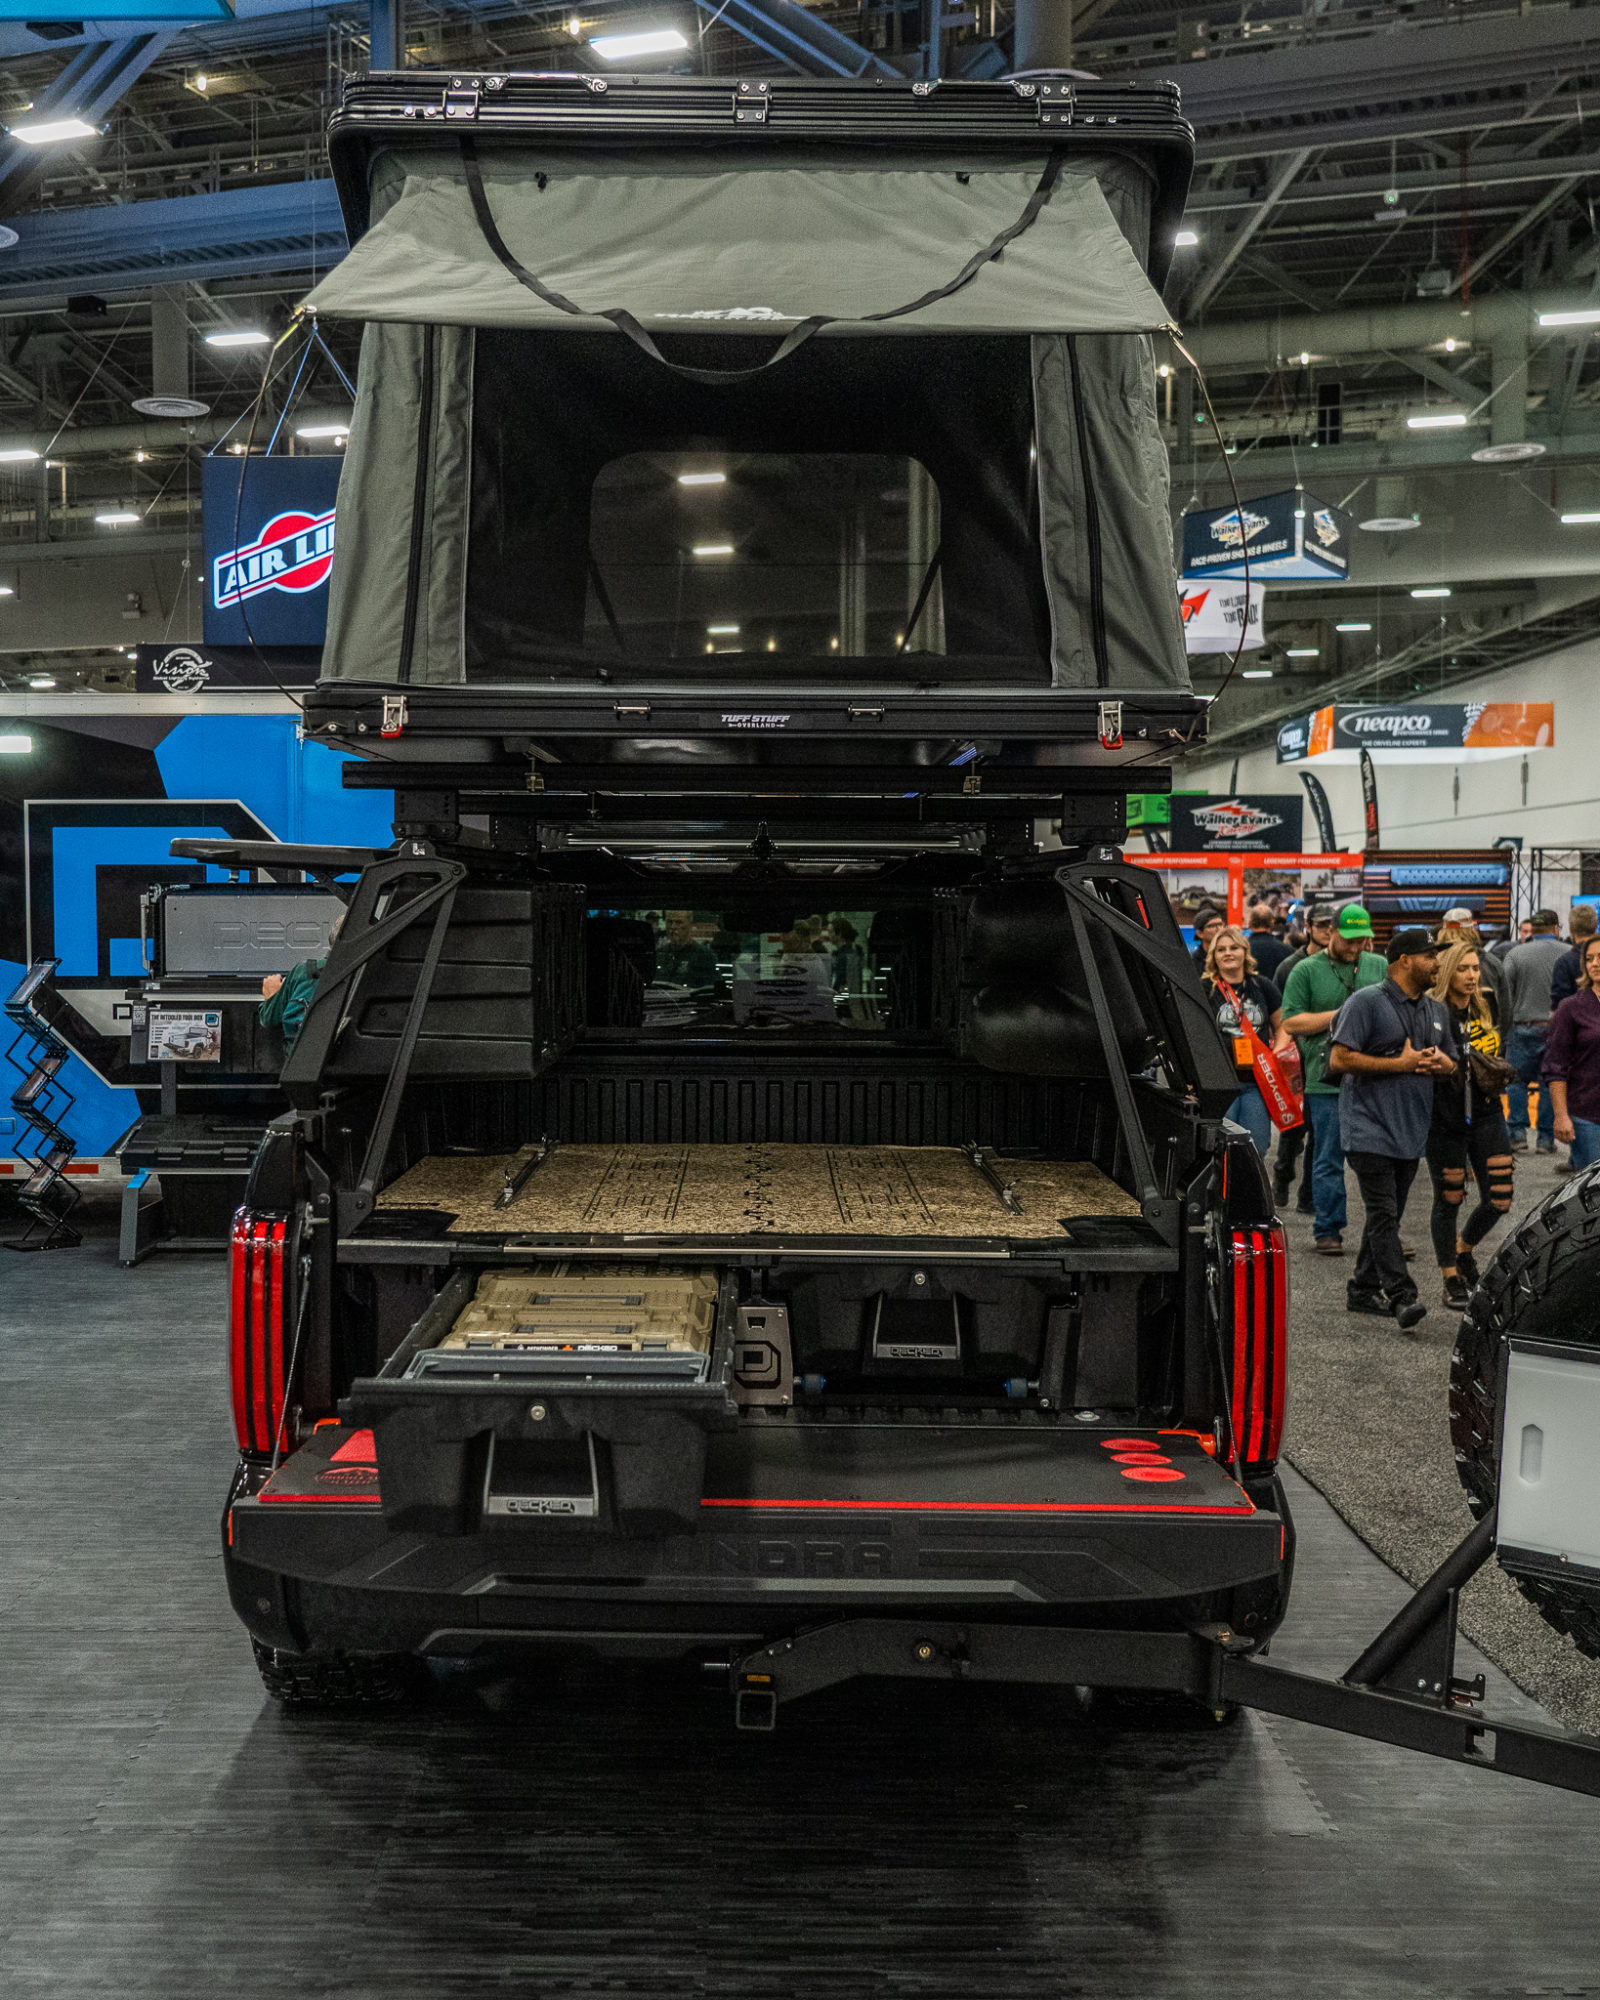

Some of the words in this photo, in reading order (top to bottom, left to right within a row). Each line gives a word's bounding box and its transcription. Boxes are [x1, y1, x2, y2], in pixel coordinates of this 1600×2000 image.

[224, 547, 289, 594] AIR
[153, 660, 209, 678] Vision
[721, 714, 752, 723] TUFF
[751, 714, 791, 723] STUFF
[1354, 715, 1432, 737] neapco
[1195, 813, 1238, 826] Walker
[1240, 814, 1278, 825] Evans
[1257, 1053, 1288, 1111] SPYDER
[889, 1347, 943, 1358] DECKED
[507, 1499, 575, 1514] DECKED
